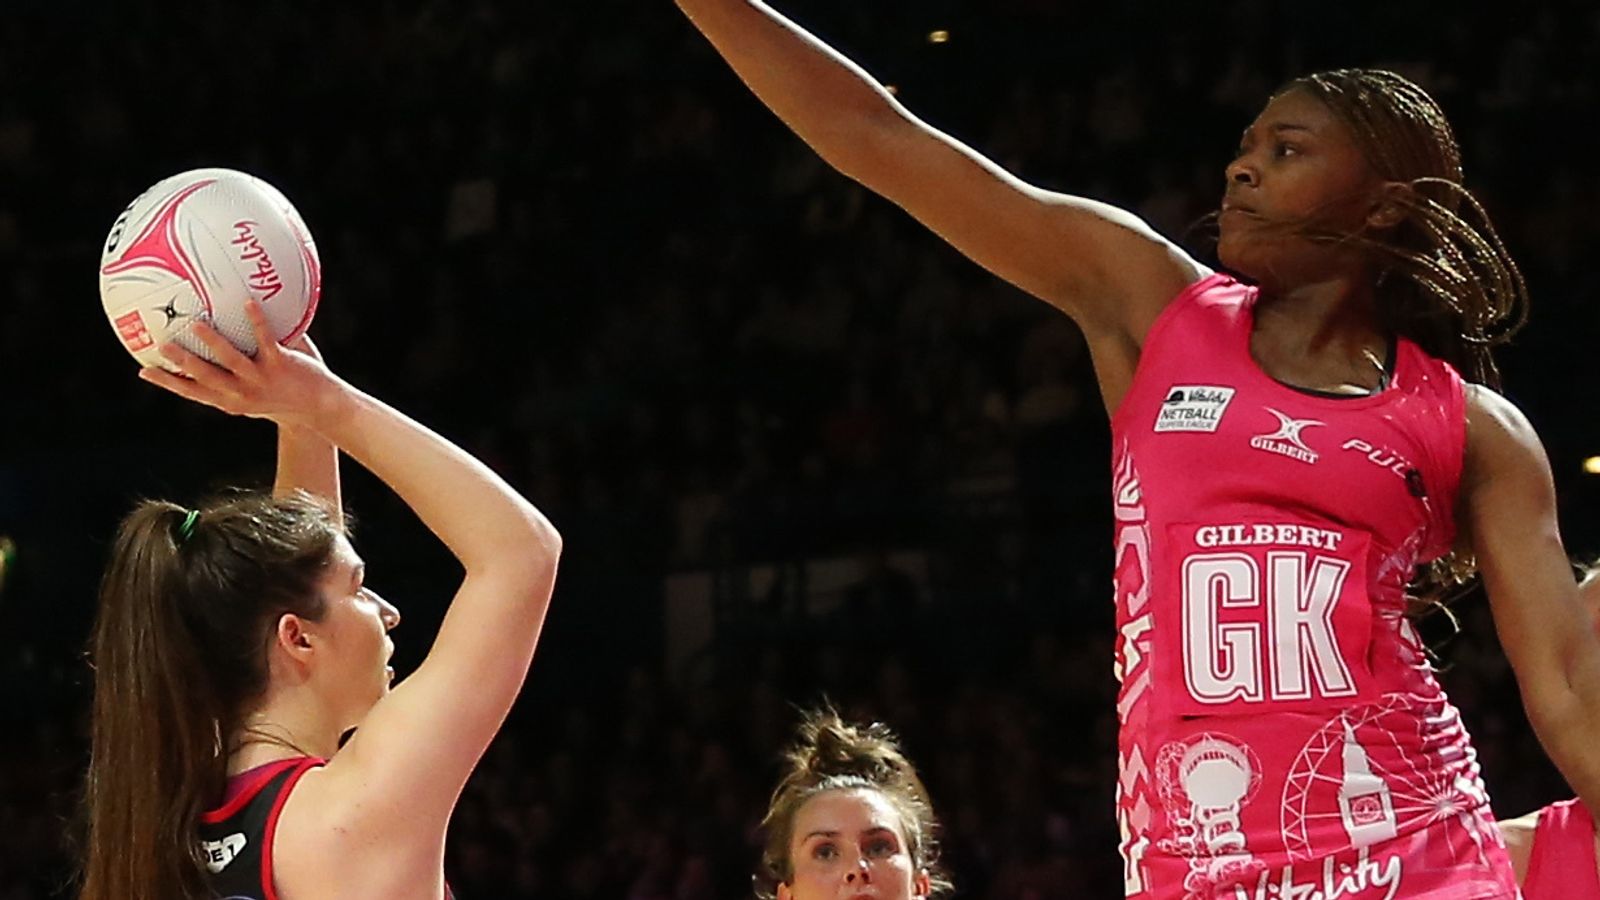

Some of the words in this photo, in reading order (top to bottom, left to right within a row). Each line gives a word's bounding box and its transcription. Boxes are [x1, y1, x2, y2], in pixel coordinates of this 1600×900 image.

[231, 219, 283, 302] Vitality
[1160, 407, 1218, 420] NETBALL
[1250, 435, 1319, 465] GILBERT
[1342, 439, 1406, 480] PUL
[1196, 524, 1342, 550] GILBERT
[1181, 551, 1358, 704] GK
